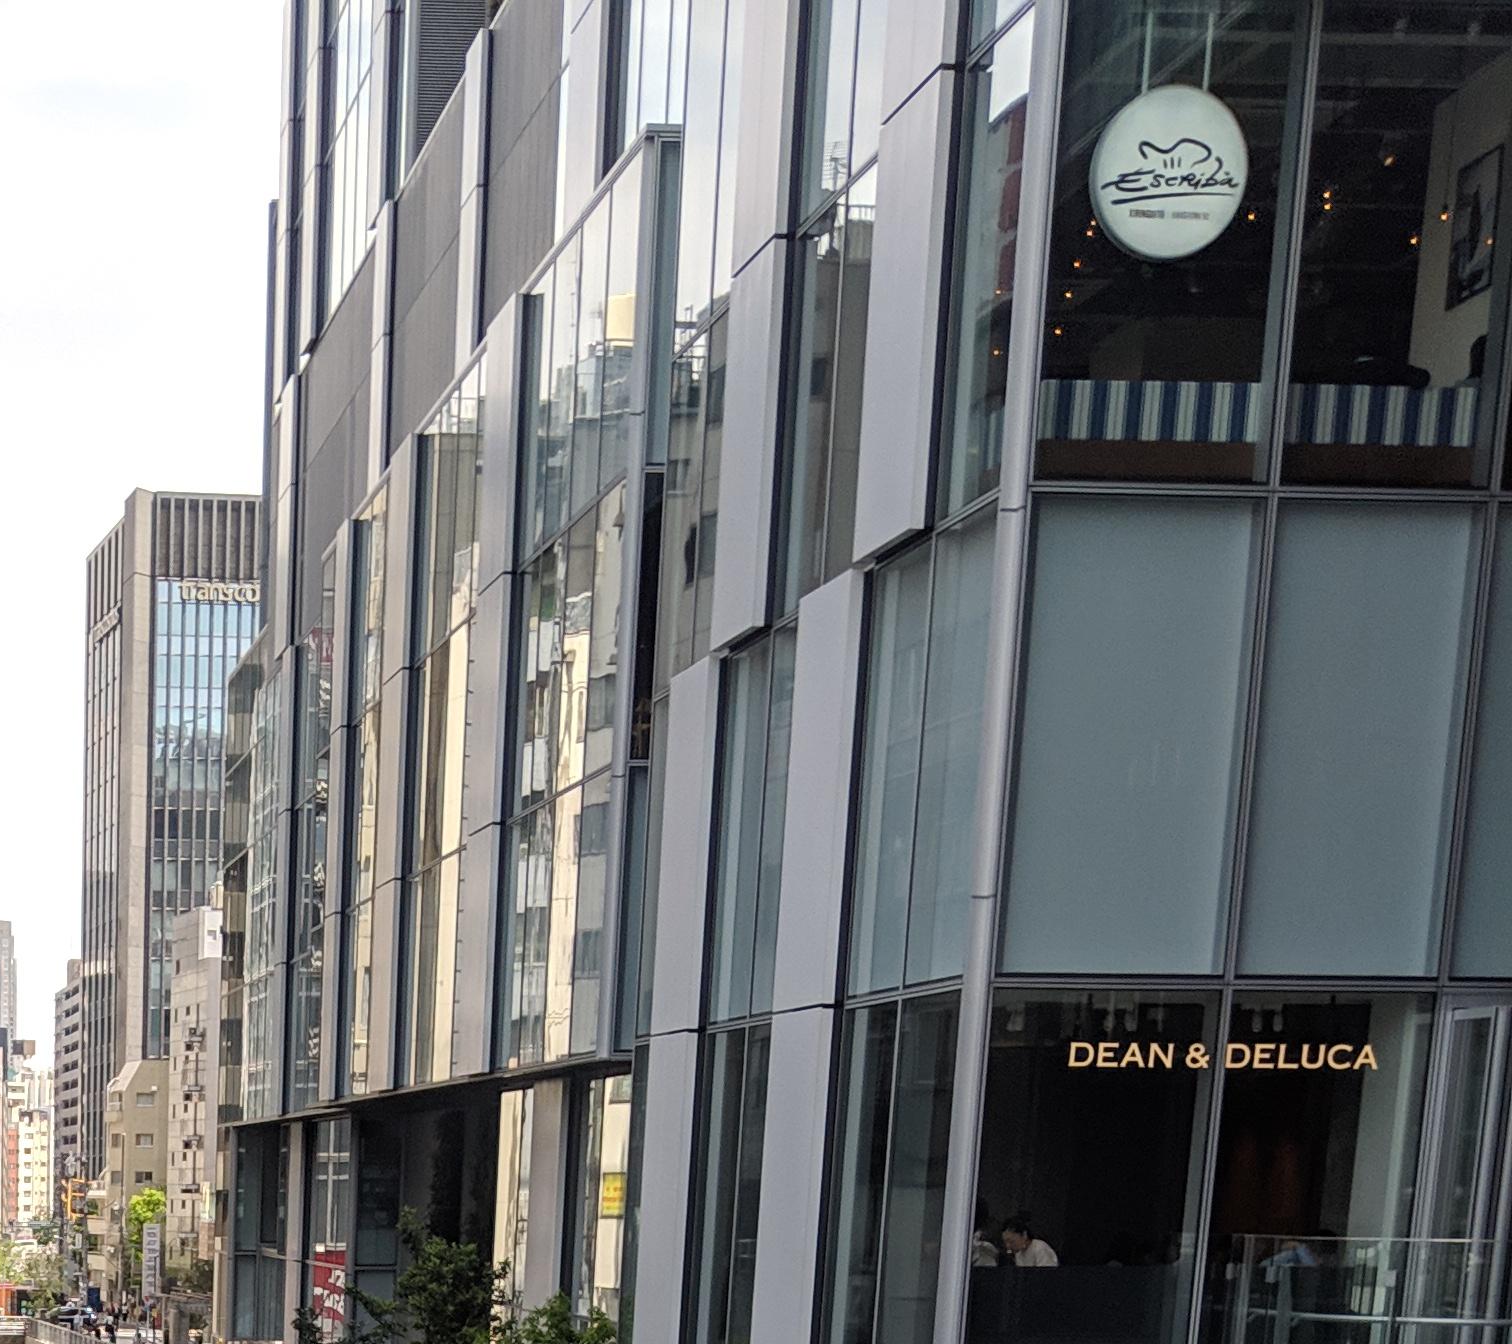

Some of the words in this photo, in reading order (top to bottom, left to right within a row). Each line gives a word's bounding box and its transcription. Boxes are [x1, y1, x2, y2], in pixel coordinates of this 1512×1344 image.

[1067, 1042, 1175, 1069] DEAN
[1185, 1043, 1211, 1069] &
[1224, 1043, 1378, 1071] DELUCA
